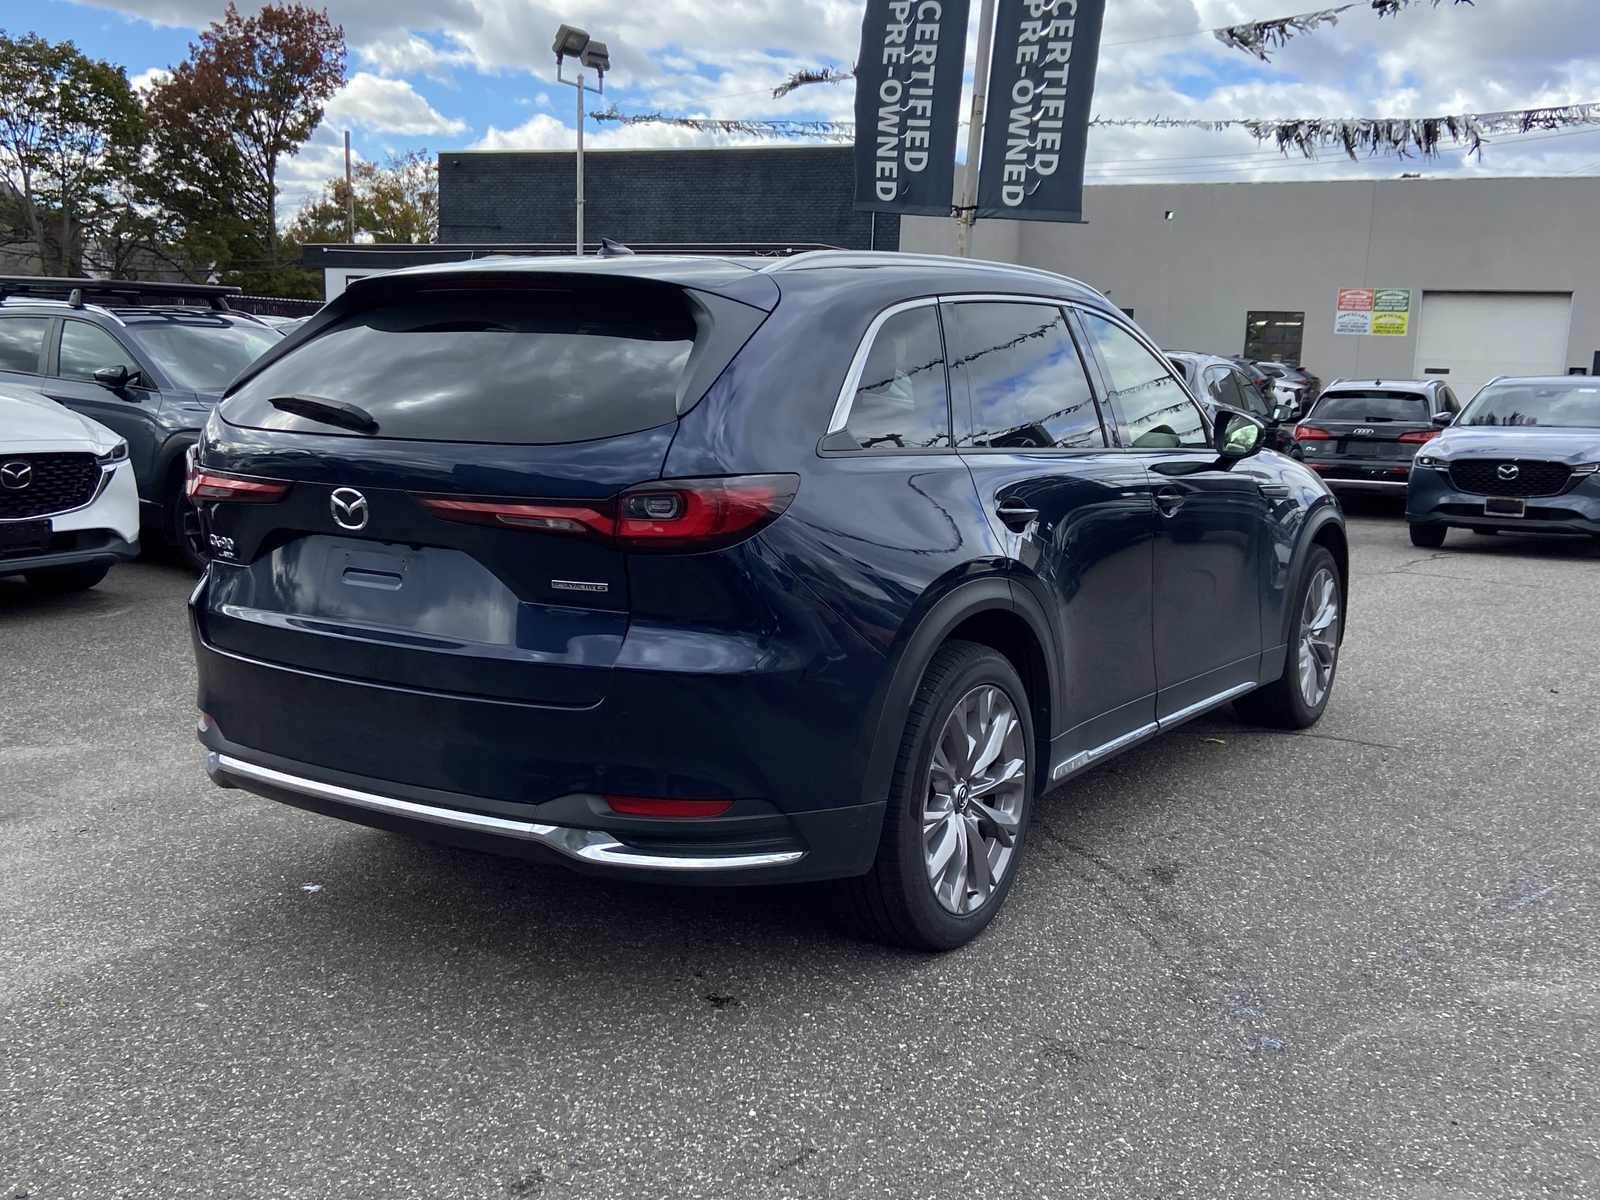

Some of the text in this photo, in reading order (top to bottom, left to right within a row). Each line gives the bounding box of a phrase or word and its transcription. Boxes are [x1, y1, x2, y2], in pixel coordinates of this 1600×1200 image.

[875, 1, 910, 201] PRE-OWNED
[904, 0, 942, 172] CERTIFIED
[1002, 0, 1044, 207] PRE-OWNED
[1034, 0, 1078, 176] CERTIFIED
[1374, 313, 1406, 321] OFFICIAL
